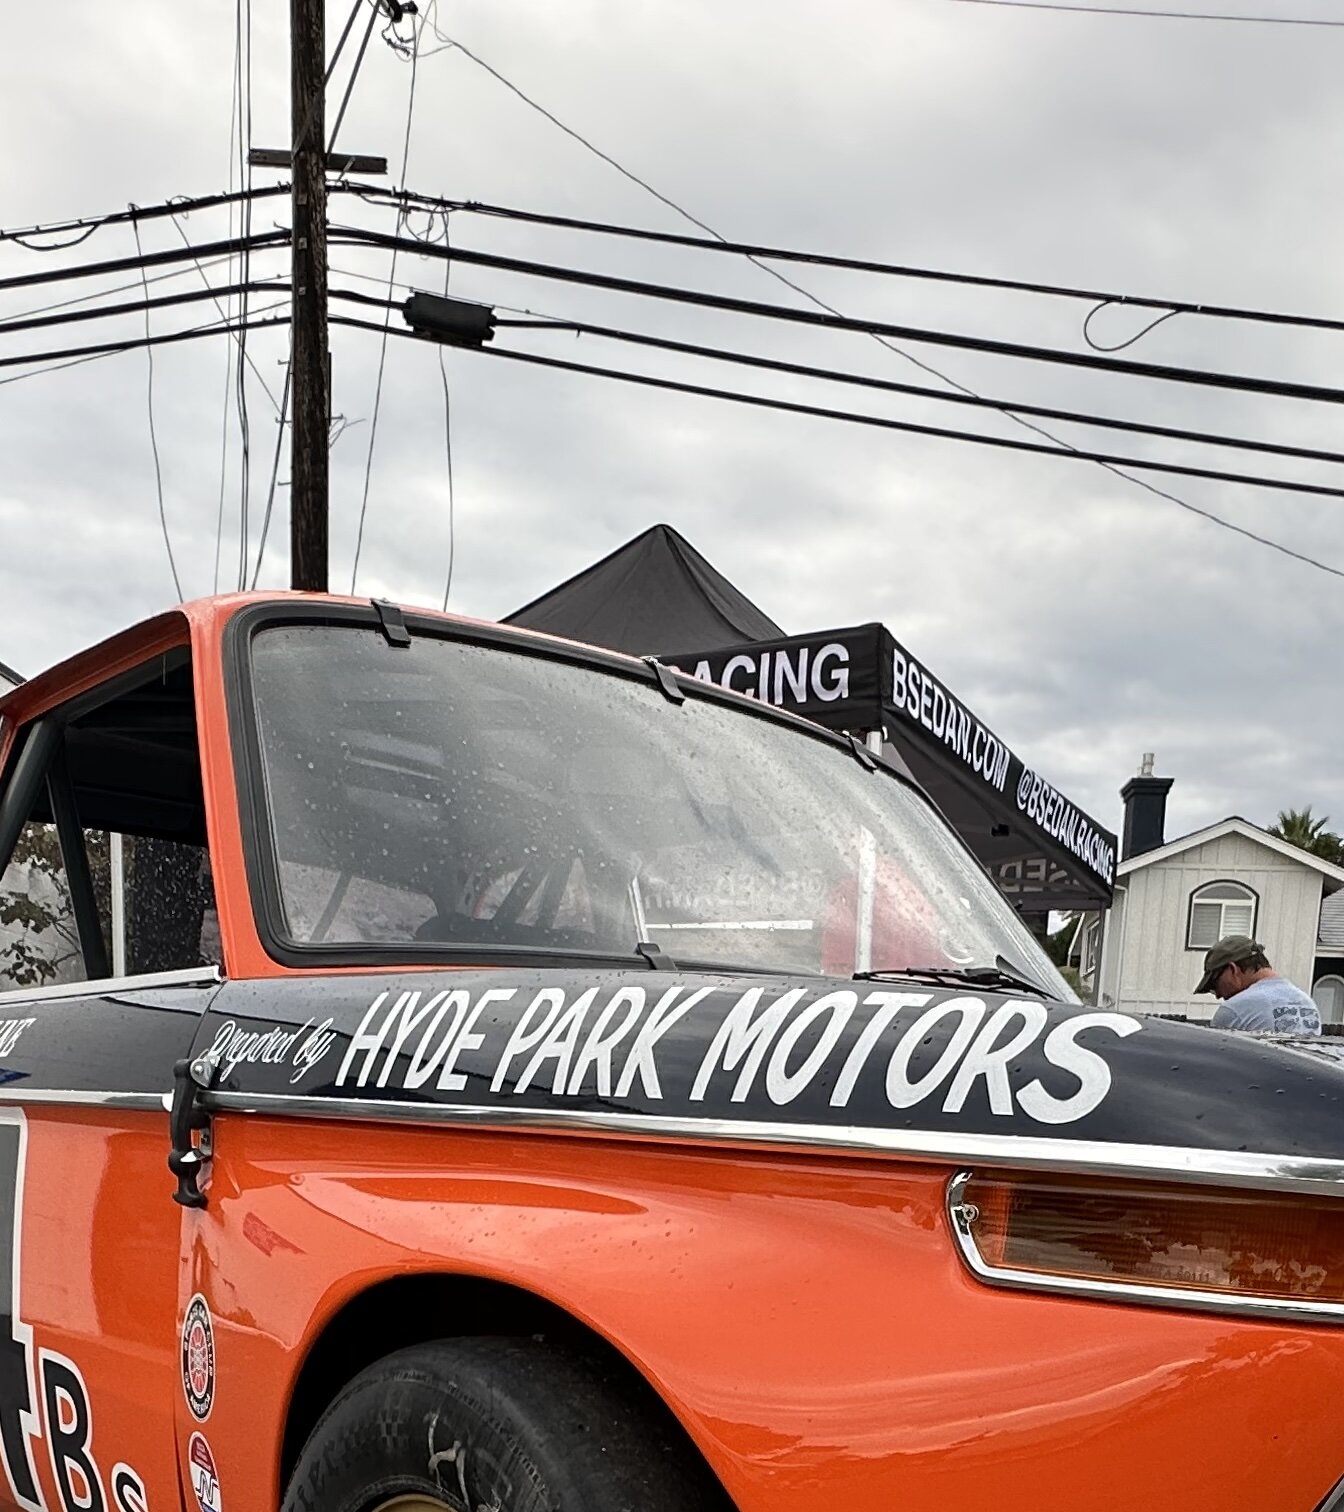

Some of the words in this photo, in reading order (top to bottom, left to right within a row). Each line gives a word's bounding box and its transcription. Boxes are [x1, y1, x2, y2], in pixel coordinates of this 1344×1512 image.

[670, 643, 850, 706] ACING
[892, 648, 1011, 792] BSEDAN.COM
[1016, 764, 1114, 886] @BSEDAN.RACING
[202, 1016, 315, 1083] Prepared
[289, 1016, 337, 1085] by
[334, 987, 518, 1092] HYDE
[489, 985, 718, 1100] PARK
[688, 986, 1143, 1125] MOTORS
